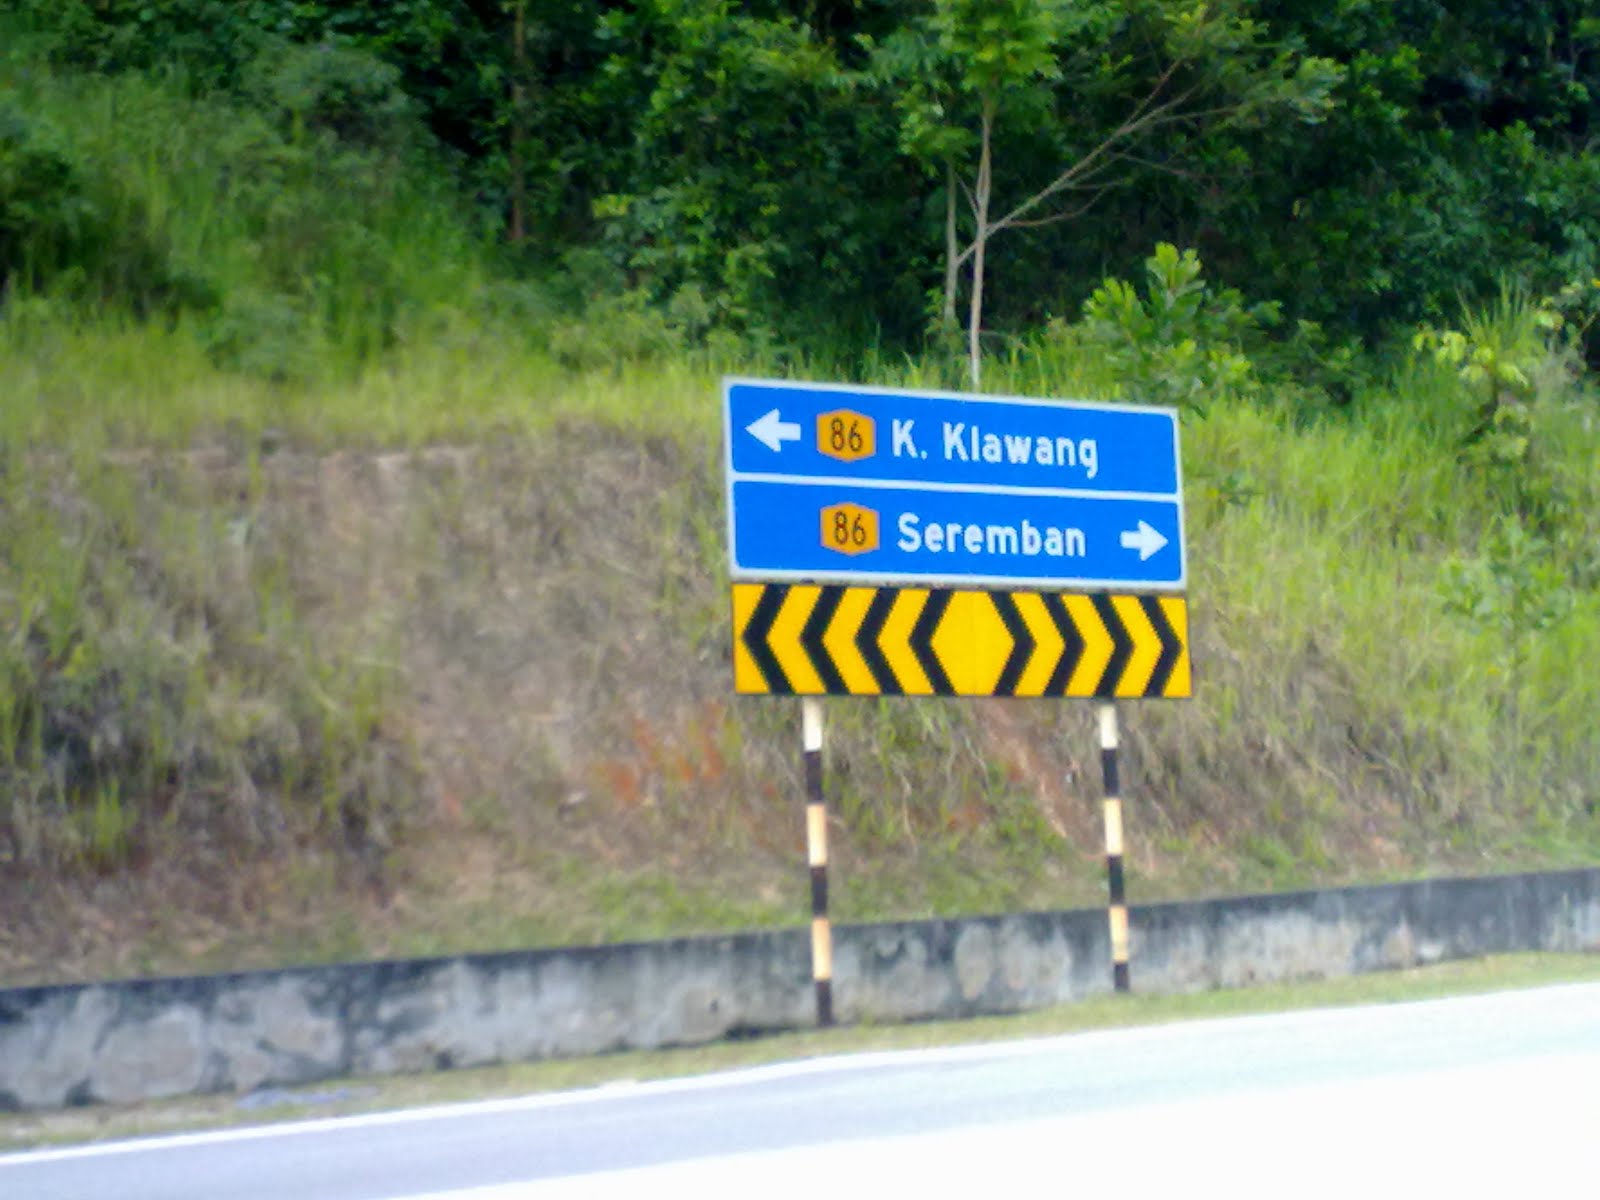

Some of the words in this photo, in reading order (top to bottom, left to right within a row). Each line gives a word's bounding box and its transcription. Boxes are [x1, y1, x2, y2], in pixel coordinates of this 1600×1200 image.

[830, 417, 863, 453] 86
[891, 419, 927, 460] K.
[942, 421, 1098, 479] Klawang
[833, 510, 867, 547] 86
[896, 512, 1087, 557] Seremban
